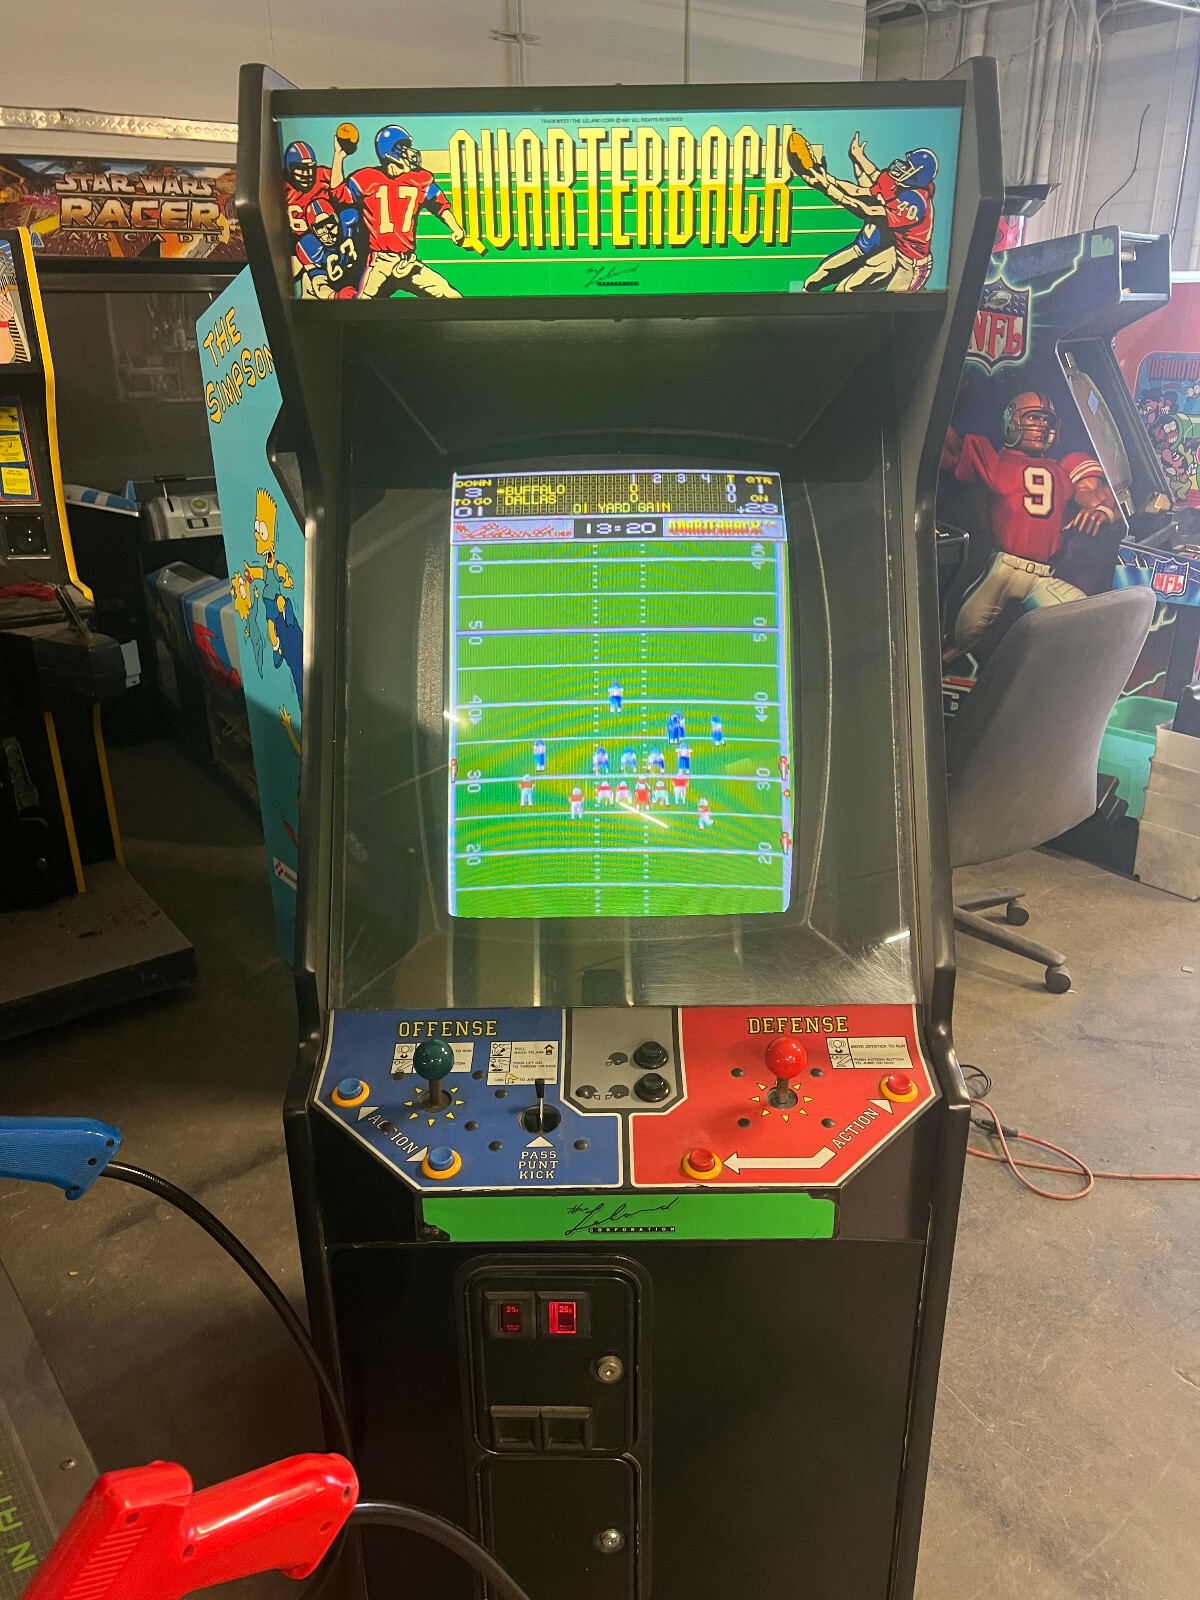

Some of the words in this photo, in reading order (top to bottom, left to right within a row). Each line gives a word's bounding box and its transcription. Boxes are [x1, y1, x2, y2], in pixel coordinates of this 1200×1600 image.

[56, 172, 135, 194] STAR
[140, 175, 217, 197] WARS
[449, 124, 793, 255] QUARTERBACK
[61, 198, 221, 230] RACER
[375, 185, 419, 234] 17
[897, 200, 918, 221] 40
[68, 232, 220, 244] ARCADE
[203, 306, 242, 367] THE
[968, 311, 1024, 359] NFL
[456, 479, 492, 488] DOWN
[653, 474, 662, 484] 2
[678, 474, 686, 484] 3
[701, 474, 711, 484] 4
[505, 485, 565, 496] BUFFALO
[750, 494, 769, 503] ON
[1022, 466, 1055, 519] 9
[505, 495, 557, 505] DALLAS
[598, 502, 630, 514] YARD
[638, 502, 671, 513] GAIN
[1152, 572, 1184, 594] NFL
[398, 1020, 497, 1038] OFFENSE
[748, 1016, 849, 1034] DEFENSE
[368, 1114, 419, 1154] ACION
[831, 1107, 880, 1150] ACTION
[522, 1151, 557, 1160] PASS
[519, 1160, 558, 1170] PUNT
[520, 1171, 554, 1180] KICK
